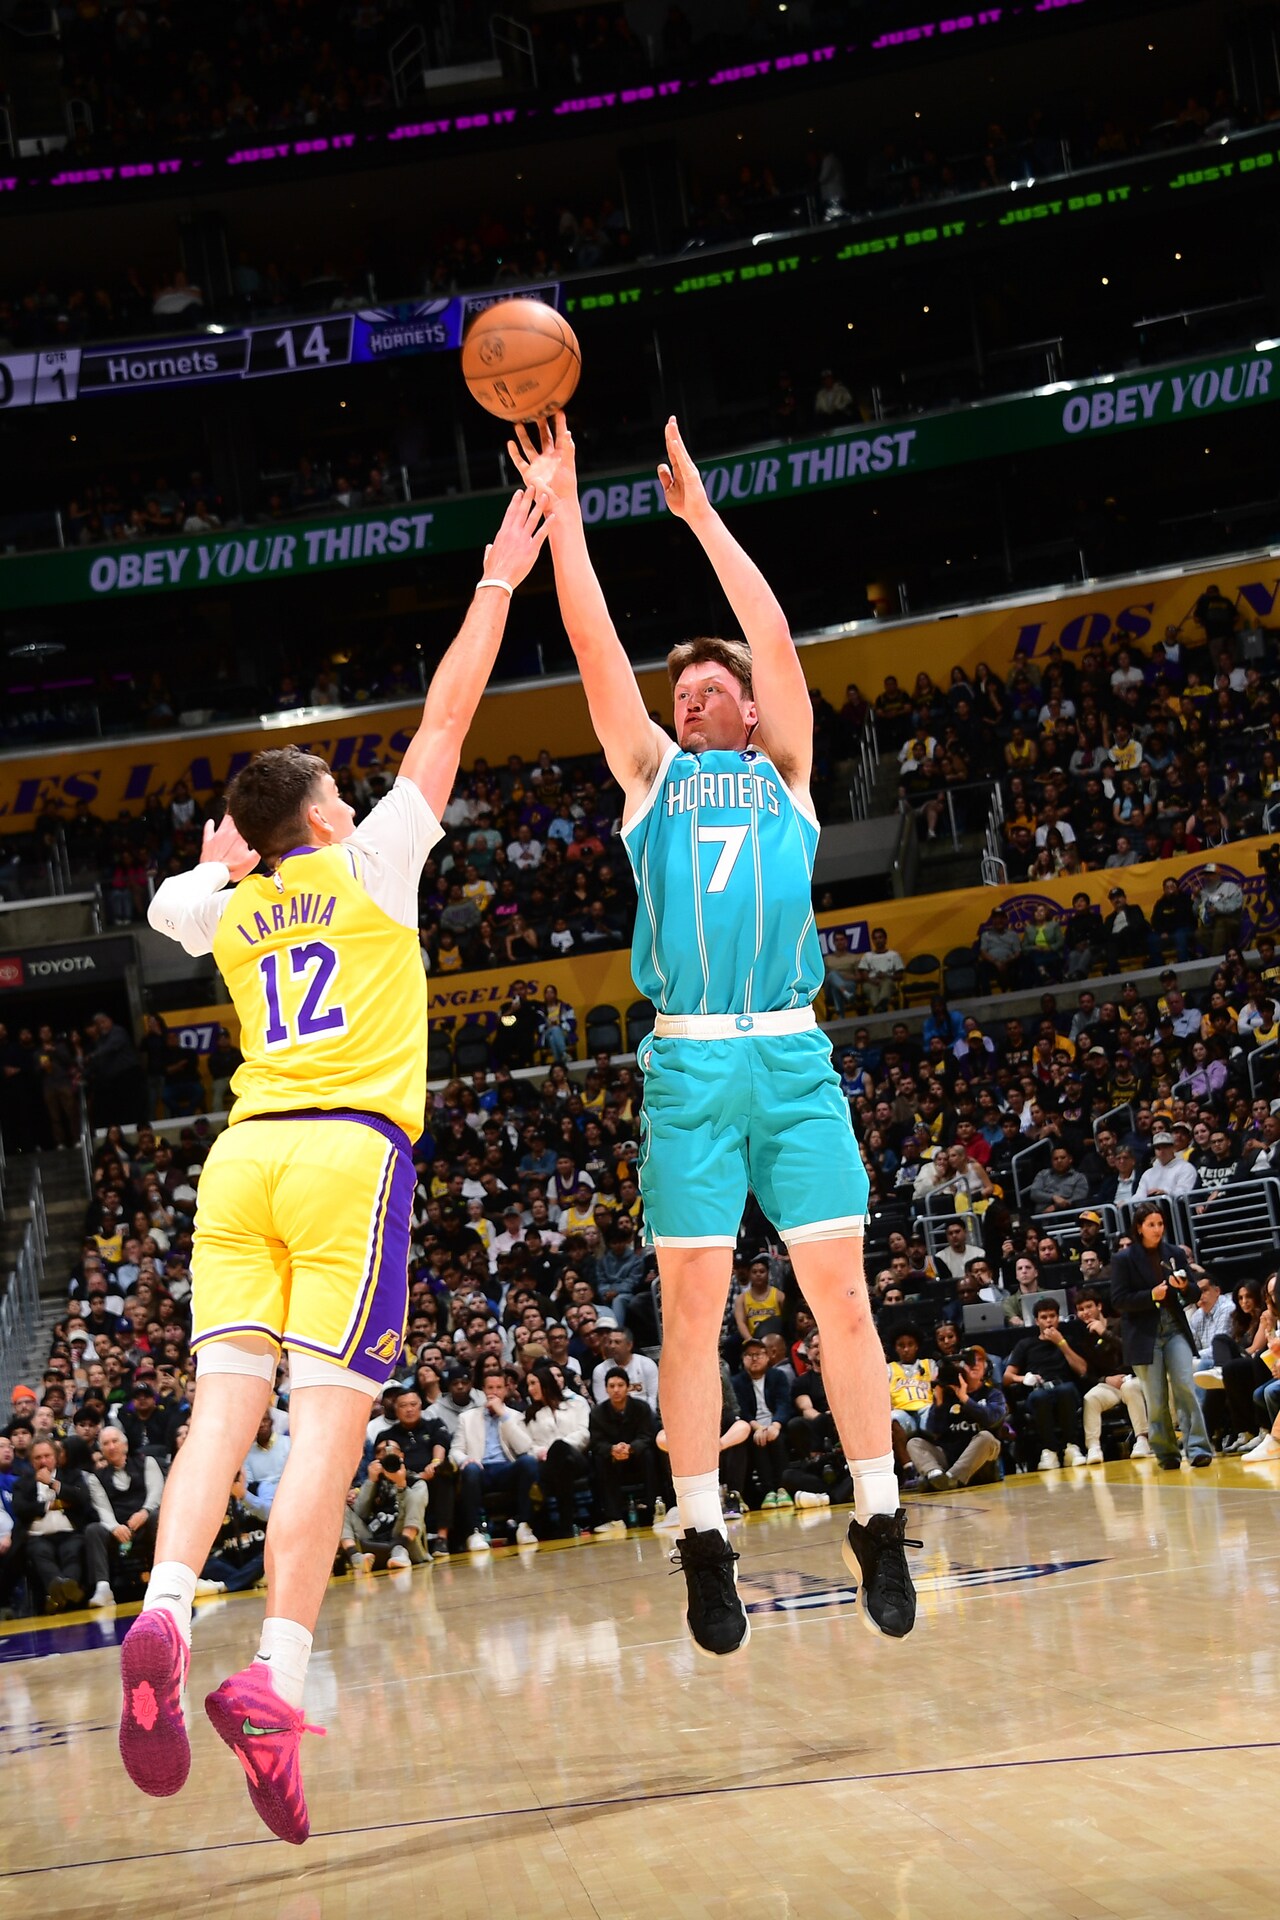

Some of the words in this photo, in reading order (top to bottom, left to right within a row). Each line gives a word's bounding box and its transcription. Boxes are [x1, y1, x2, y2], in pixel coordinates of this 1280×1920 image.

[871, 23, 936, 49] JUST
[938, 15, 975, 34] DO
[978, 8, 1002, 26] IT
[708, 60, 771, 85] JUST
[774, 53, 809, 71] DO
[812, 45, 837, 64] IT
[553, 93, 617, 116] JUST
[620, 85, 655, 104] DO
[658, 80, 683, 96] IT
[387, 119, 451, 142] JUST
[454, 113, 490, 132] DO
[492, 108, 517, 125] IT
[226, 143, 291, 165] JUST
[293, 137, 329, 155] DO
[331, 132, 356, 150] IT
[50, 166, 115, 187] JUST
[118, 162, 155, 180] DO
[157, 157, 183, 175] IT
[1168, 163, 1233, 189] JUST
[1237, 152, 1274, 173] DO
[998, 200, 1063, 226] JUST
[1067, 192, 1103, 212] DO
[1107, 185, 1132, 202] IT
[836, 235, 900, 261] JUST
[903, 226, 939, 247] DO
[941, 220, 966, 239] IT
[672, 269, 737, 294] JUST
[738, 261, 774, 281] DO
[776, 254, 801, 273] IT
[580, 292, 615, 311] DO
[618, 287, 643, 305] IT
[275, 324, 331, 369] 14
[370, 325, 446, 354] HORNETS
[51, 367, 69, 401] 1
[107, 351, 220, 383] Hornets
[1062, 380, 1164, 434] OBEY
[1170, 358, 1273, 414] YOUR
[699, 457, 782, 504] OUR
[787, 429, 917, 489] THIRST
[88, 547, 190, 593] OBEY
[197, 534, 297, 580] YOUR
[303, 513, 434, 566] THIRST
[1010, 602, 1155, 662] LOS
[663, 771, 781, 818] HORNETS
[697, 824, 752, 894] 7
[236, 893, 337, 946] LARAVIA
[28, 955, 96, 977] TOYOTA
[259, 939, 347, 1052] 12
[906, 1386, 927, 1401] 10
